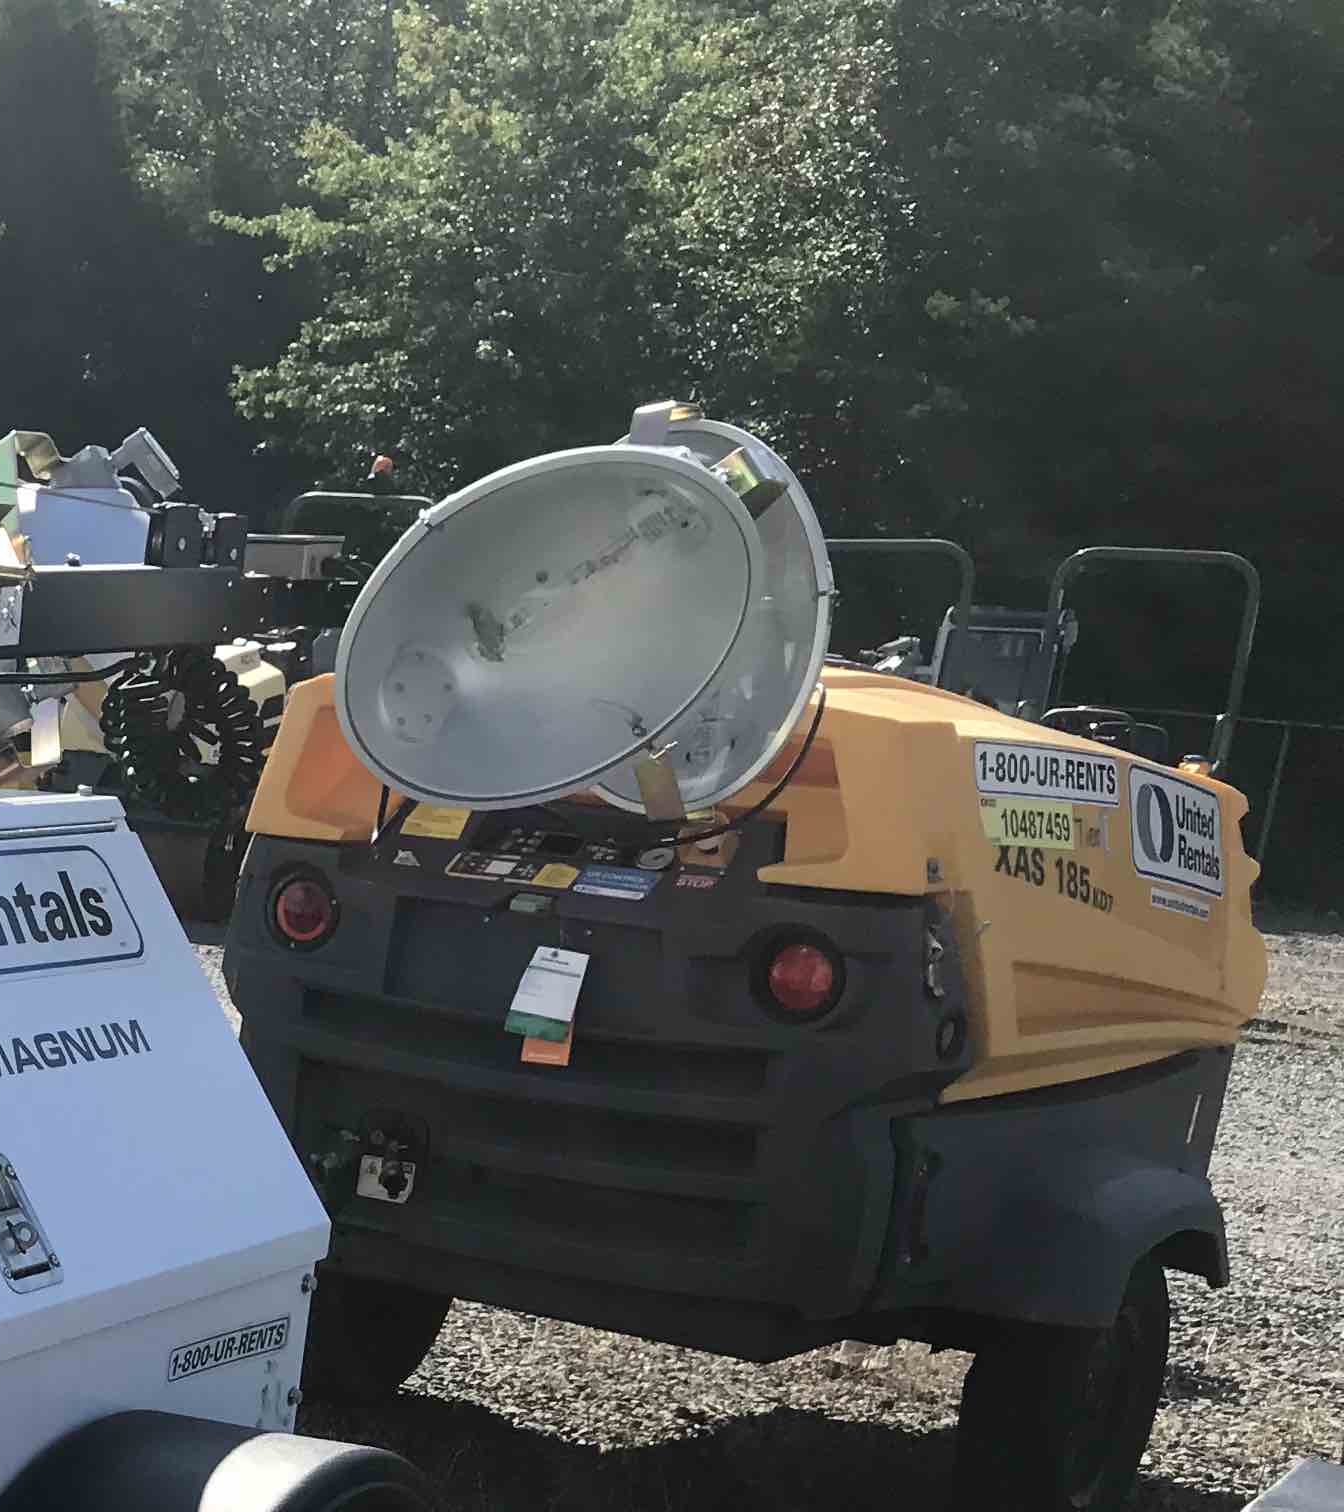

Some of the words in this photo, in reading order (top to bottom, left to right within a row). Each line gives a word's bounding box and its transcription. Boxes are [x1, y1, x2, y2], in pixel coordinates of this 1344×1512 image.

[978, 750, 1116, 795] 1-800-UR-RENTS
[1001, 808, 1071, 842] 10487459
[1175, 795, 1215, 841] United
[994, 845, 1045, 887] XAS
[1055, 856, 1090, 904] 185
[1177, 834, 1220, 881] Rentals
[171, 1322, 286, 1377] 1-800-UR-RENTS
